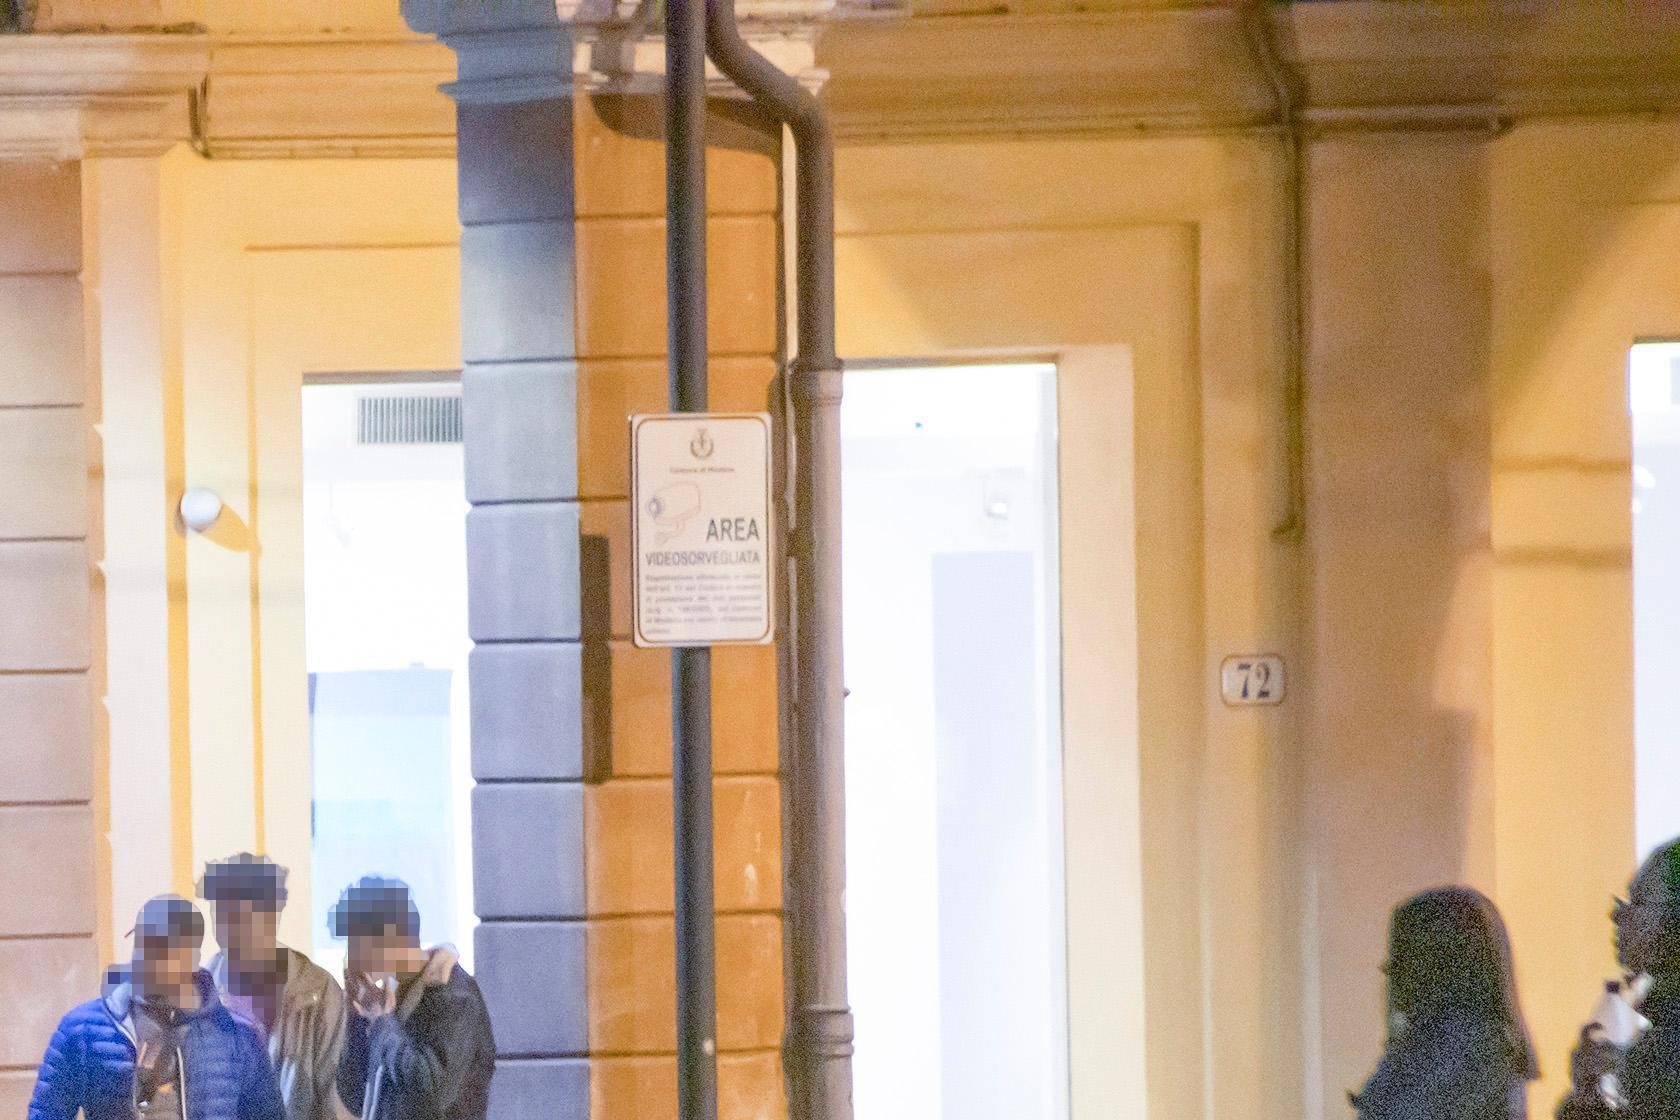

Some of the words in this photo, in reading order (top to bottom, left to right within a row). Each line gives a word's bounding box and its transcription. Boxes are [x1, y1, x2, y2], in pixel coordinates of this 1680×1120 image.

[706, 517, 760, 542] AREA
[645, 550, 760, 566] VIDEOSORVEGLIATA
[1238, 662, 1270, 698] 72
